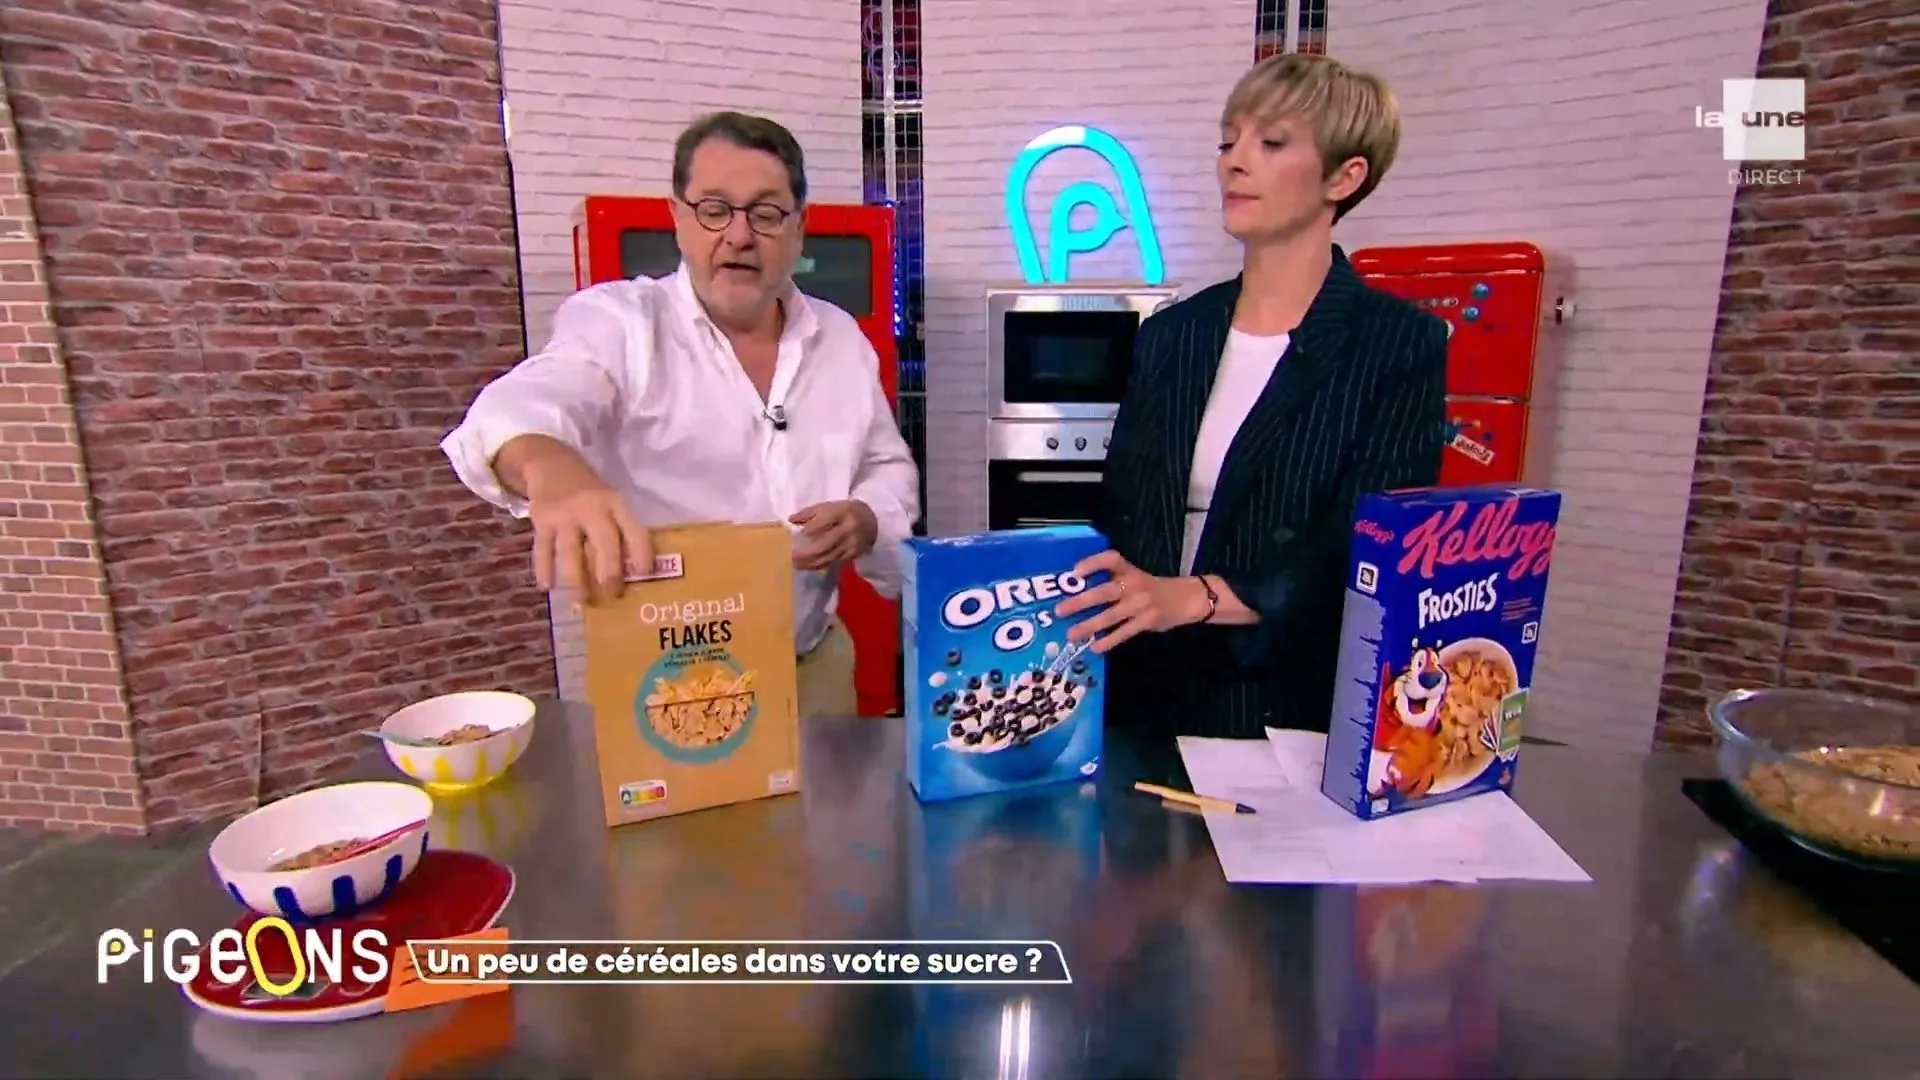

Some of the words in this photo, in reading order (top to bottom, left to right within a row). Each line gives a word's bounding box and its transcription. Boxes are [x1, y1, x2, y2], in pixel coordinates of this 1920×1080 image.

[640, 592, 745, 624] Original
[943, 570, 1086, 627] OREO
[1418, 571, 1500, 630] FROSTIES
[658, 619, 733, 651] FLAKES
